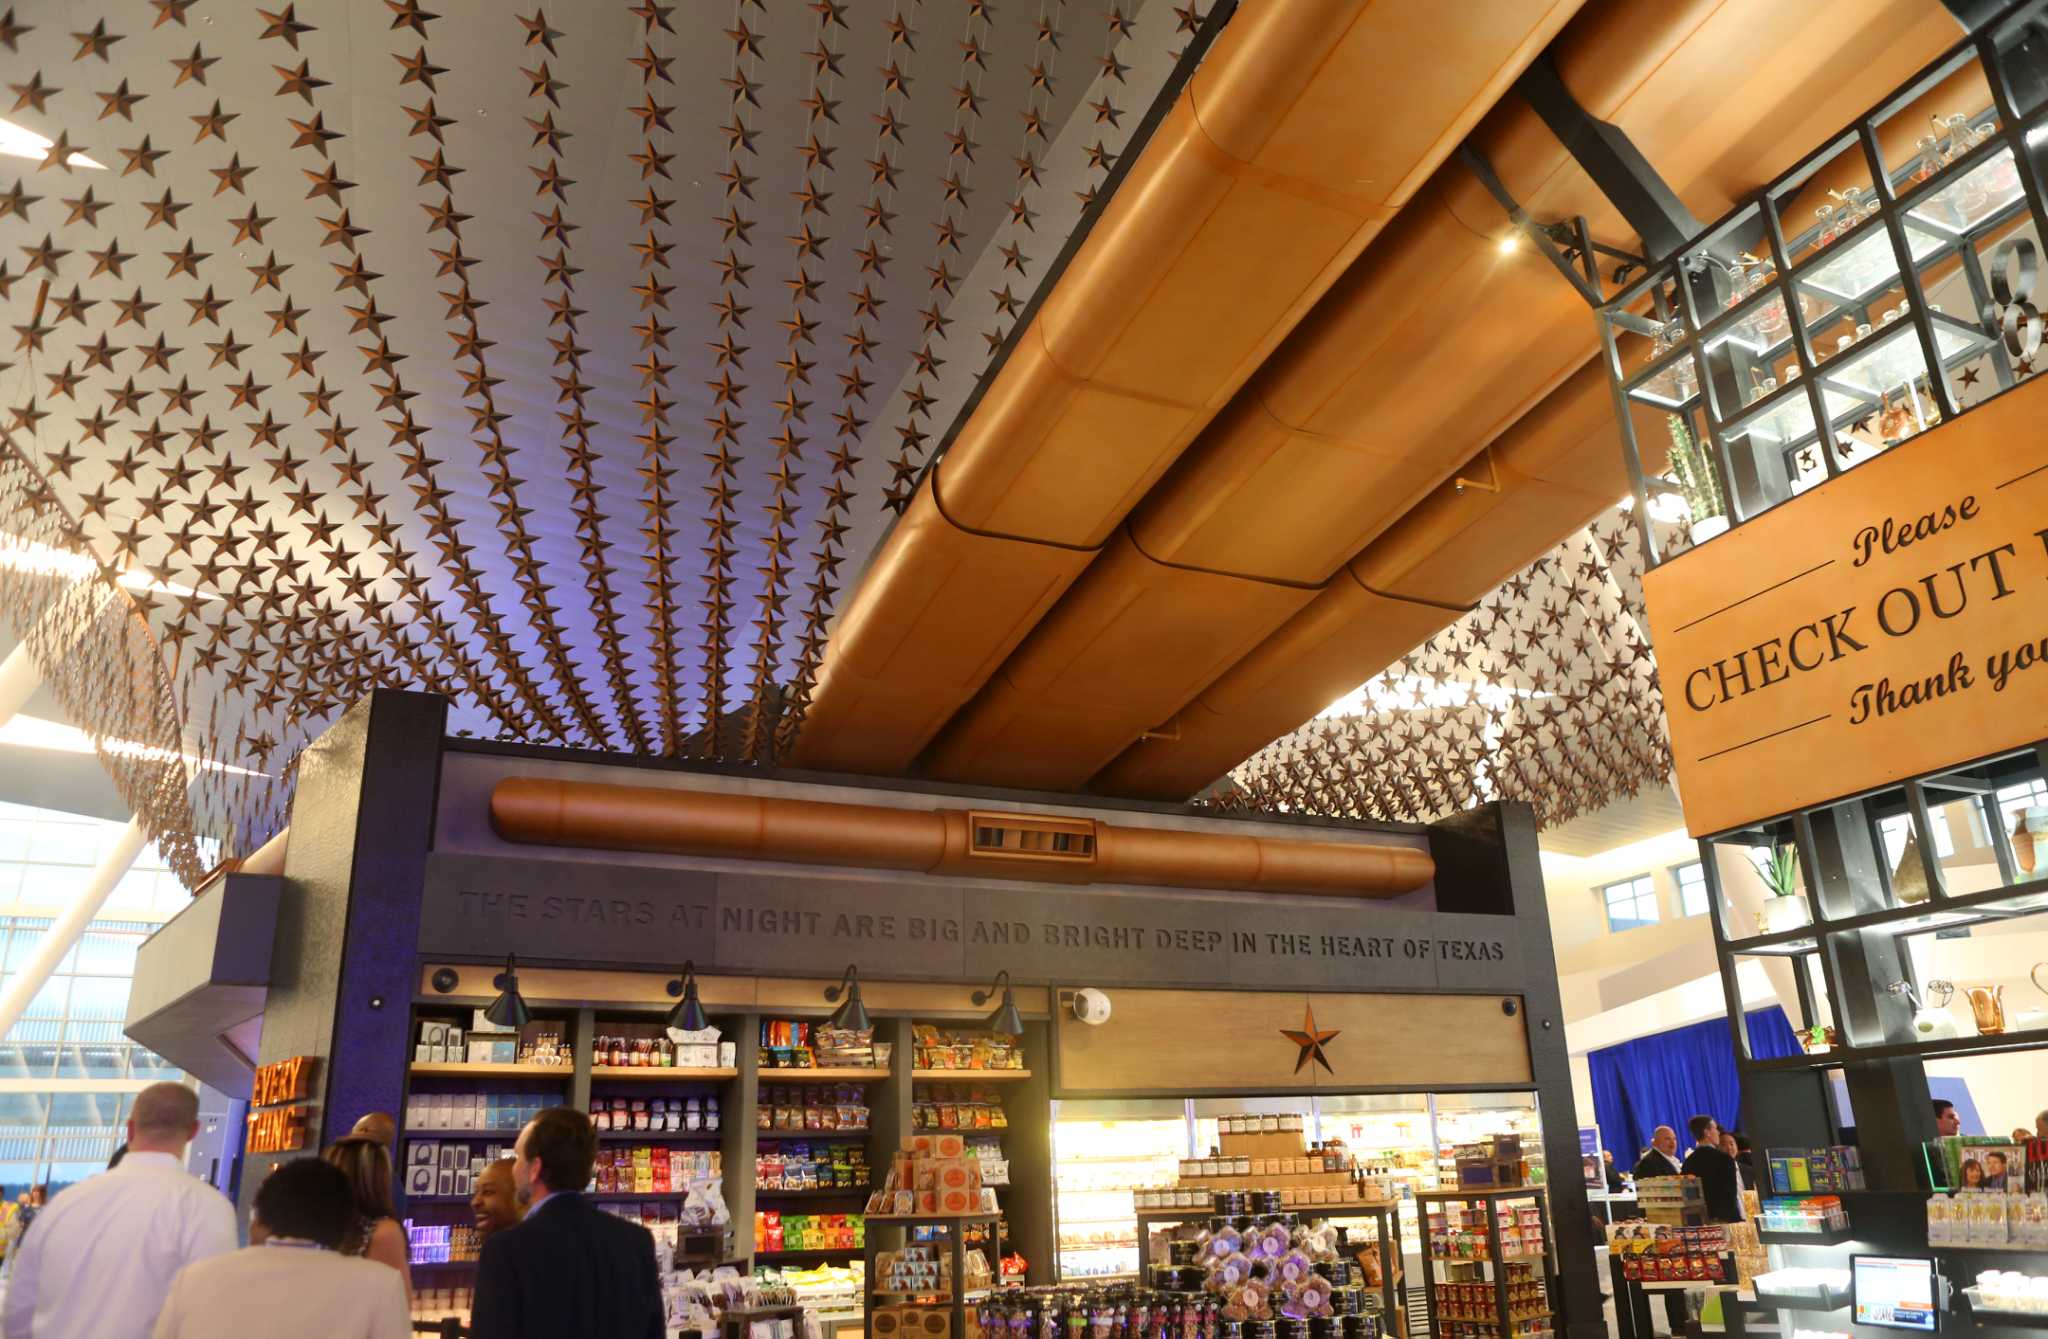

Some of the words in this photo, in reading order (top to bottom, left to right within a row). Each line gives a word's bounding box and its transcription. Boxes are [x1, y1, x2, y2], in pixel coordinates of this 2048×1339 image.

[1852, 495, 1980, 568] Please
[1684, 606, 1868, 712] CHECK
[1877, 543, 2017, 637] OUT
[1850, 651, 1975, 725] Thank
[458, 890, 529, 920] THE
[541, 895, 656, 928] STARS
[669, 904, 710, 932] AT
[722, 906, 822, 938] NIGHT
[833, 914, 896, 939] ARE
[908, 918, 960, 942] BIG
[971, 920, 1031, 945] AND
[1044, 923, 1145, 950] BRIGHT
[1156, 928, 1223, 952] DEEP
[1232, 931, 1257, 954] IN
[1265, 933, 1312, 956] THE
[1321, 935, 1394, 959] HEART
[1403, 939, 1431, 960] OF
[1438, 940, 1505, 962] TEXAS
[251, 1056, 305, 1108] EVERY
[246, 1104, 305, 1153] THING
